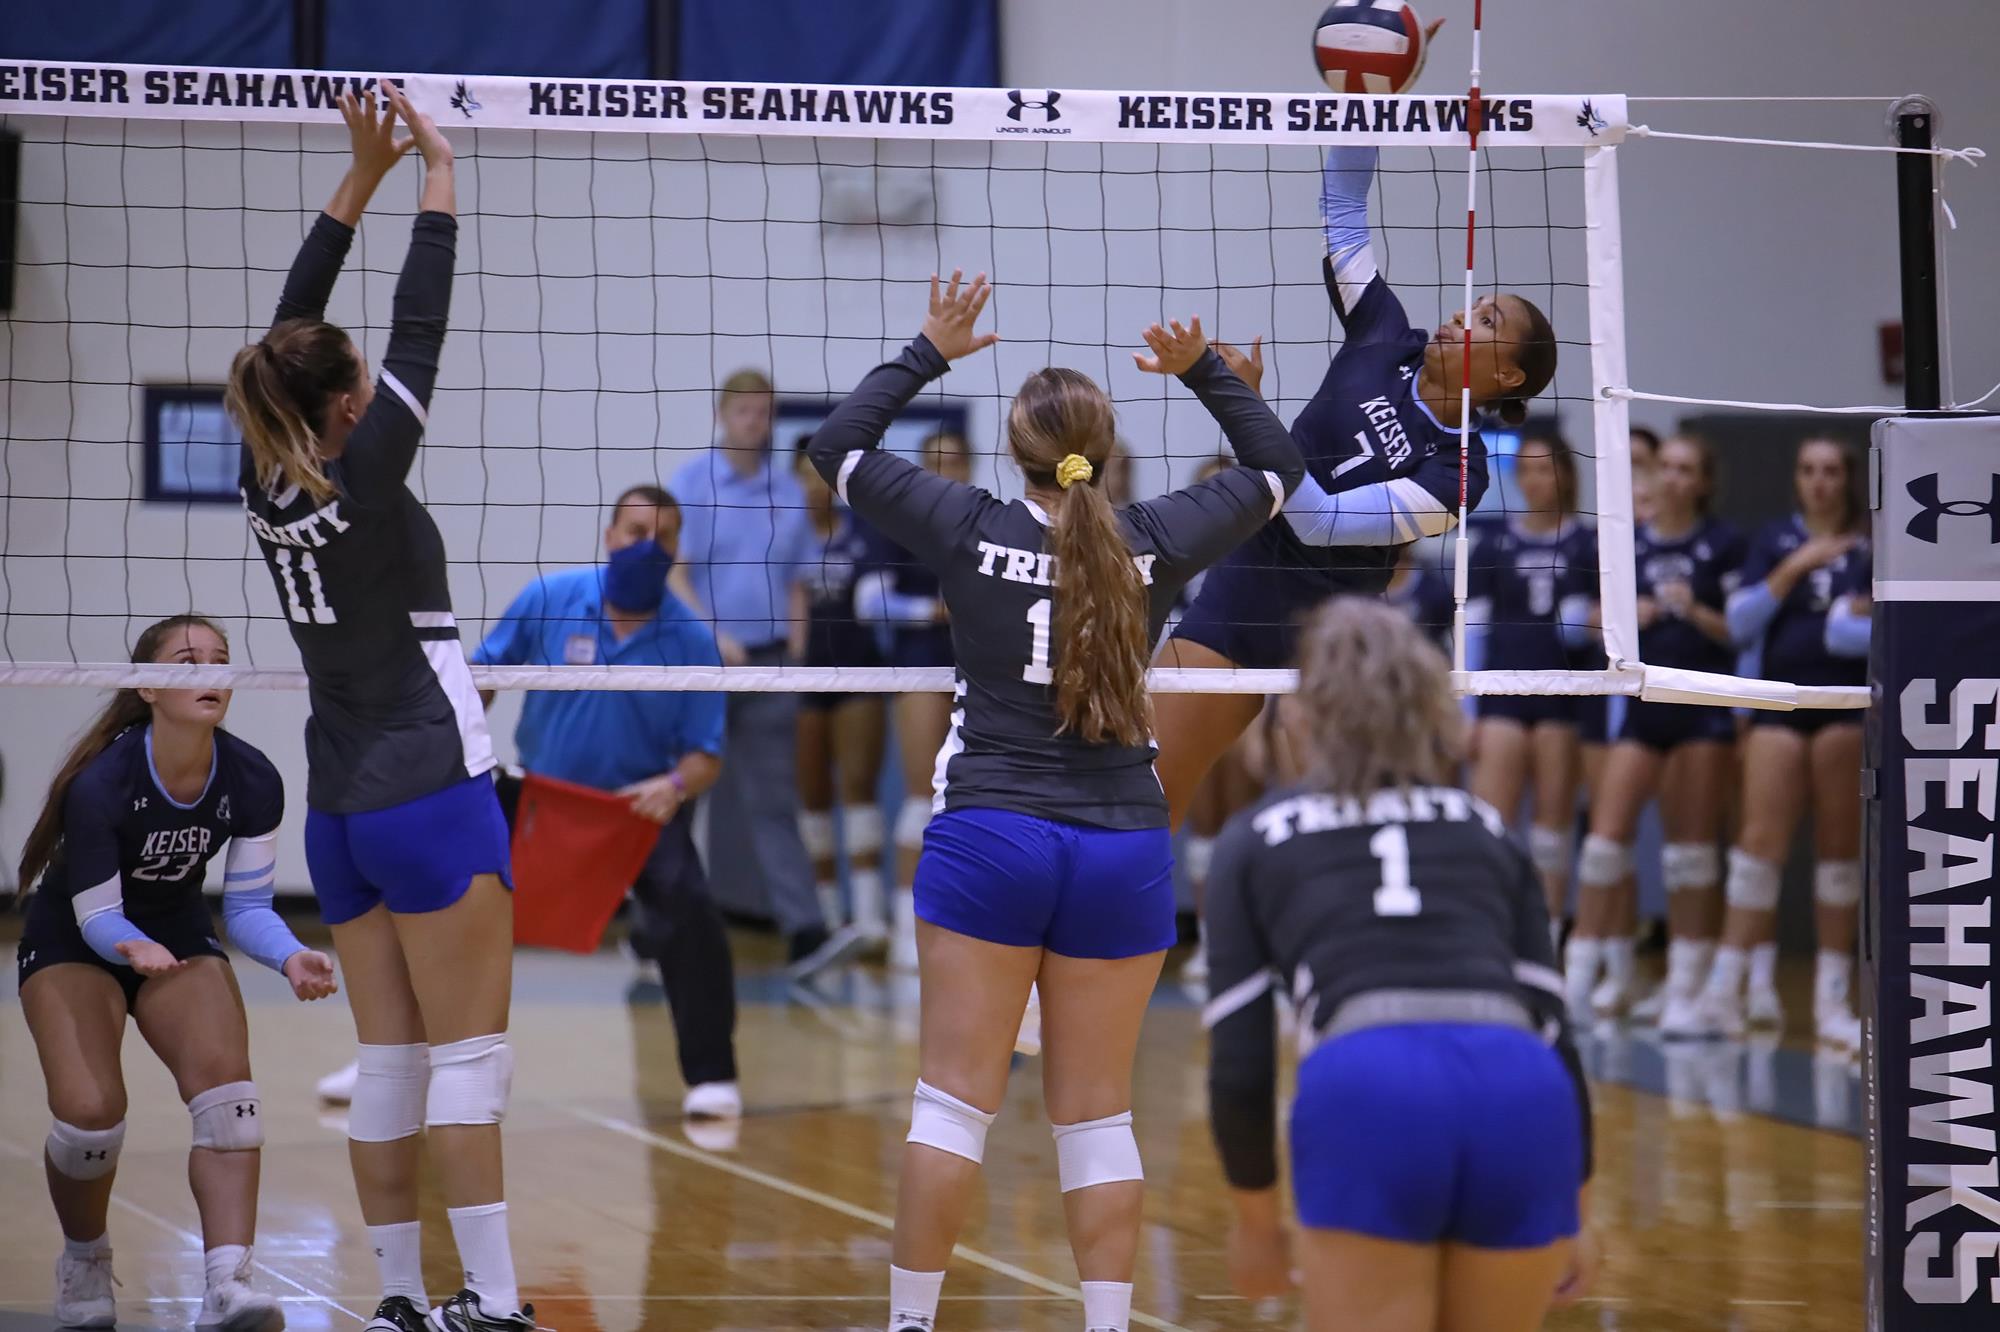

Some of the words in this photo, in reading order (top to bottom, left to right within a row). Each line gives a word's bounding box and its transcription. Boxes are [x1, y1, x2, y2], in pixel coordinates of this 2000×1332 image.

[0, 66, 129, 103] EISER
[529, 82, 687, 119] KEISER
[702, 87, 953, 125] SEAHAWKS
[1118, 96, 1273, 131] KEISER
[1287, 99, 1533, 132] SEAHAWKS
[1330, 430, 1375, 480] 7
[1358, 395, 1413, 470] KEISER
[275, 548, 338, 624] 11
[977, 541, 1157, 587] TRIY
[140, 826, 211, 856] KEISER
[131, 853, 200, 881] 23
[1369, 824, 1422, 917] 1
[1900, 678, 2000, 1304] SEAHAWKS
